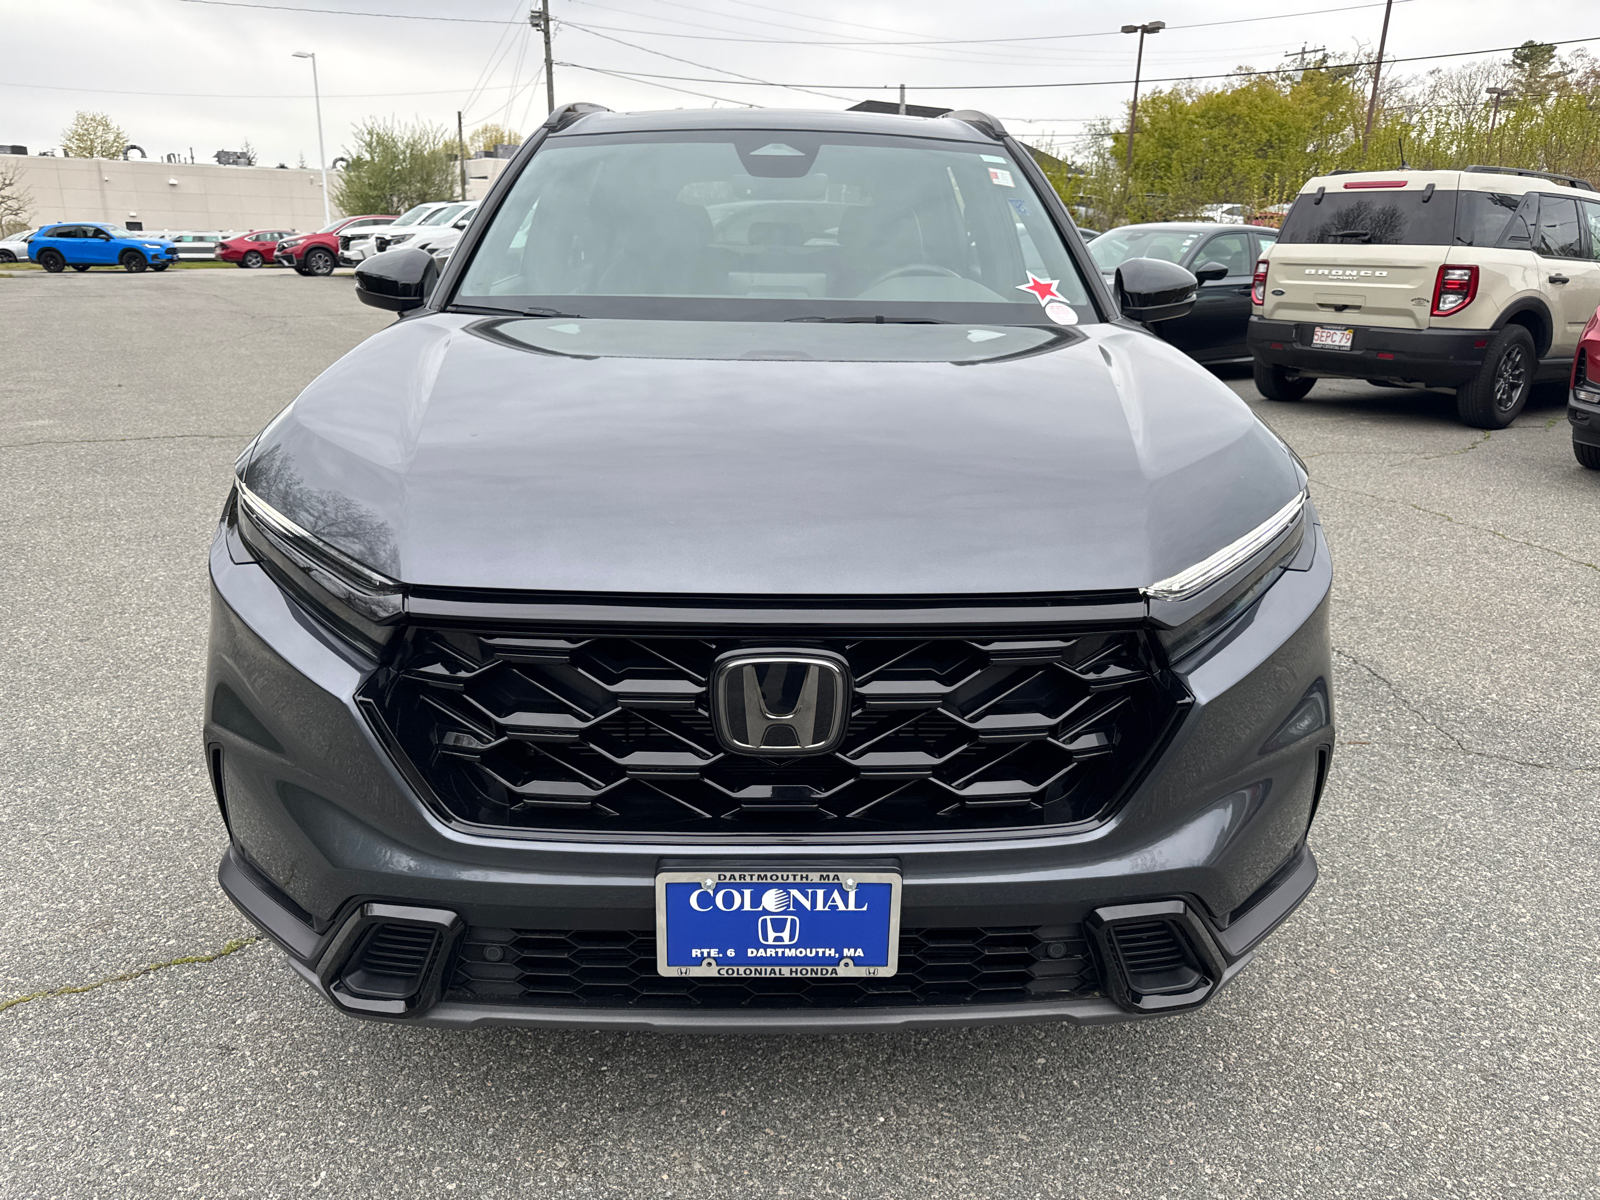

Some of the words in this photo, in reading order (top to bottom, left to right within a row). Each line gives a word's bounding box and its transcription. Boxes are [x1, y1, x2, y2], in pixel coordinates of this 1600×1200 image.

[1304, 268, 1388, 277] BRONCO
[1313, 330, 1337, 343] 5EPC
[1338, 332, 1351, 344] 79
[818, 873, 841, 882] MA
[689, 888, 868, 913] COLONIAL
[691, 948, 723, 958] RTE.
[726, 948, 736, 958] 6
[747, 948, 839, 958] DARTMOUTH,
[843, 948, 865, 957] MA
[717, 967, 785, 976] COLONIAL
[789, 967, 839, 976] HONDA
